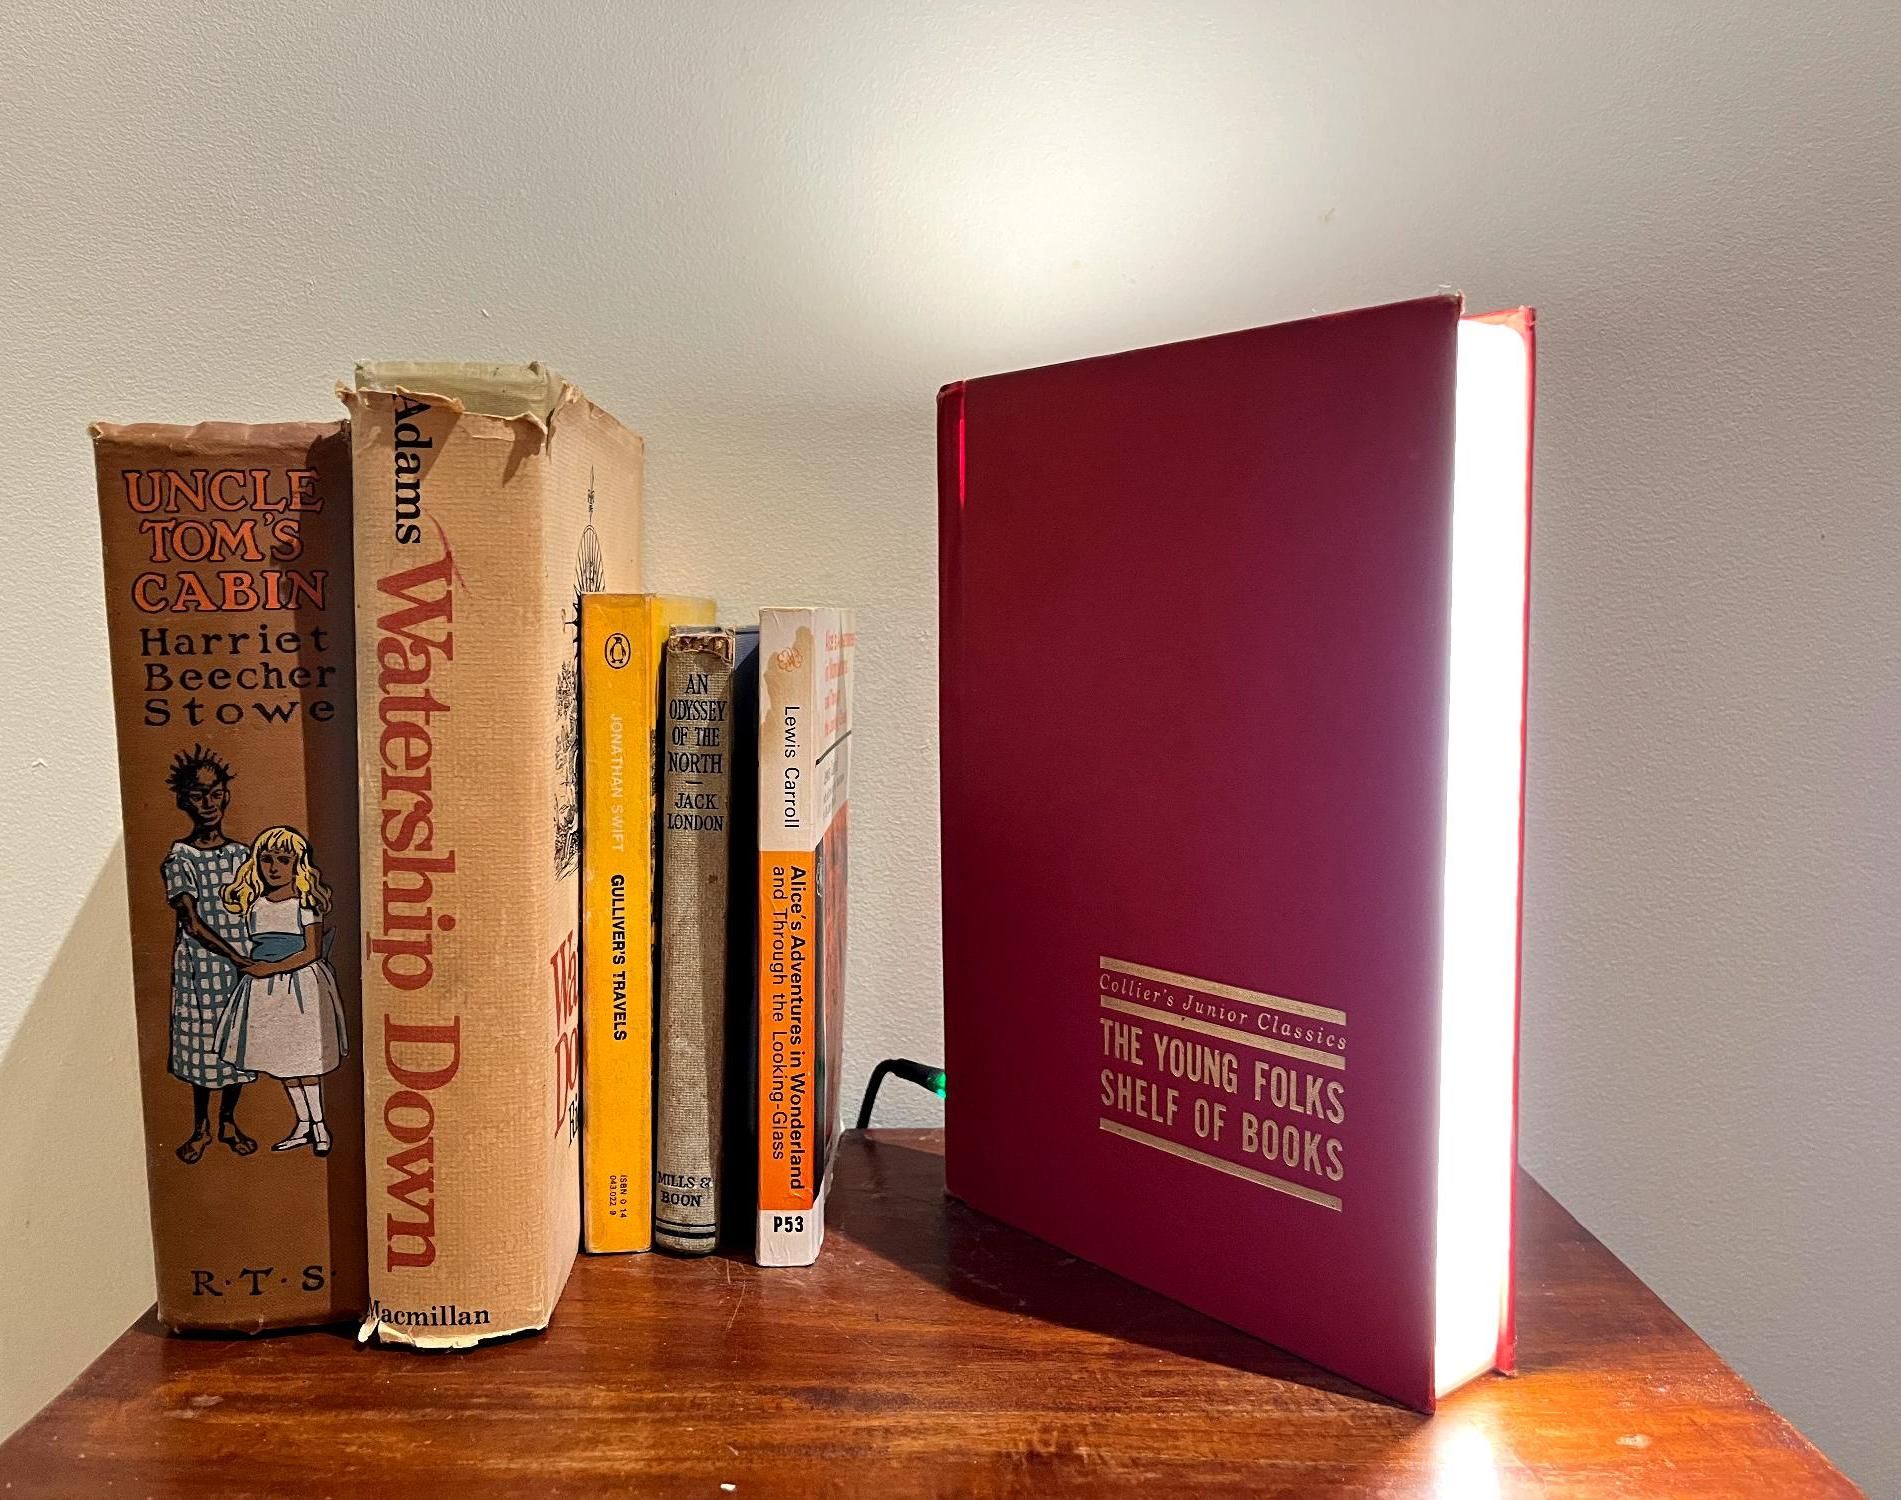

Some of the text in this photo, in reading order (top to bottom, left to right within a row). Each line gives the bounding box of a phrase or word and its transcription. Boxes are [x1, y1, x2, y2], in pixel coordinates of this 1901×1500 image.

[121, 467, 324, 513] UNCLE
[392, 394, 433, 544] Adams
[139, 511, 304, 562] TOM'S
[131, 570, 328, 613] CABIN
[139, 624, 329, 656] Harriet
[143, 662, 336, 691] Beecher
[685, 674, 709, 694] AN
[144, 698, 335, 727] Stowe
[669, 699, 727, 721] ODYSSEY
[672, 726, 720, 746] OF THE
[610, 714, 624, 852] JONATHAN SWIFT
[668, 752, 722, 774] NORTH
[784, 706, 800, 828] Lewis Carroll
[667, 813, 723, 832] LONDON
[674, 792, 719, 810] JACK
[366, 550, 461, 1273] Watership Down
[610, 874, 627, 1041] GULLIVER'S TRAVELS
[769, 866, 788, 1160] and Through the Looking-Glass
[790, 865, 806, 1189] Alice's Adventures in Wonderland
[1100, 973, 1346, 1050] Collier's Junior Classics
[555, 1027, 578, 1139] Do
[1100, 1017, 1345, 1124] THE YOUNG FOLKS
[1100, 1068, 1344, 1182] SHELF OF BOOKS
[657, 1171, 711, 1189] MILLS &
[660, 1190, 702, 1208] BOON
[773, 1215, 804, 1233] P53
